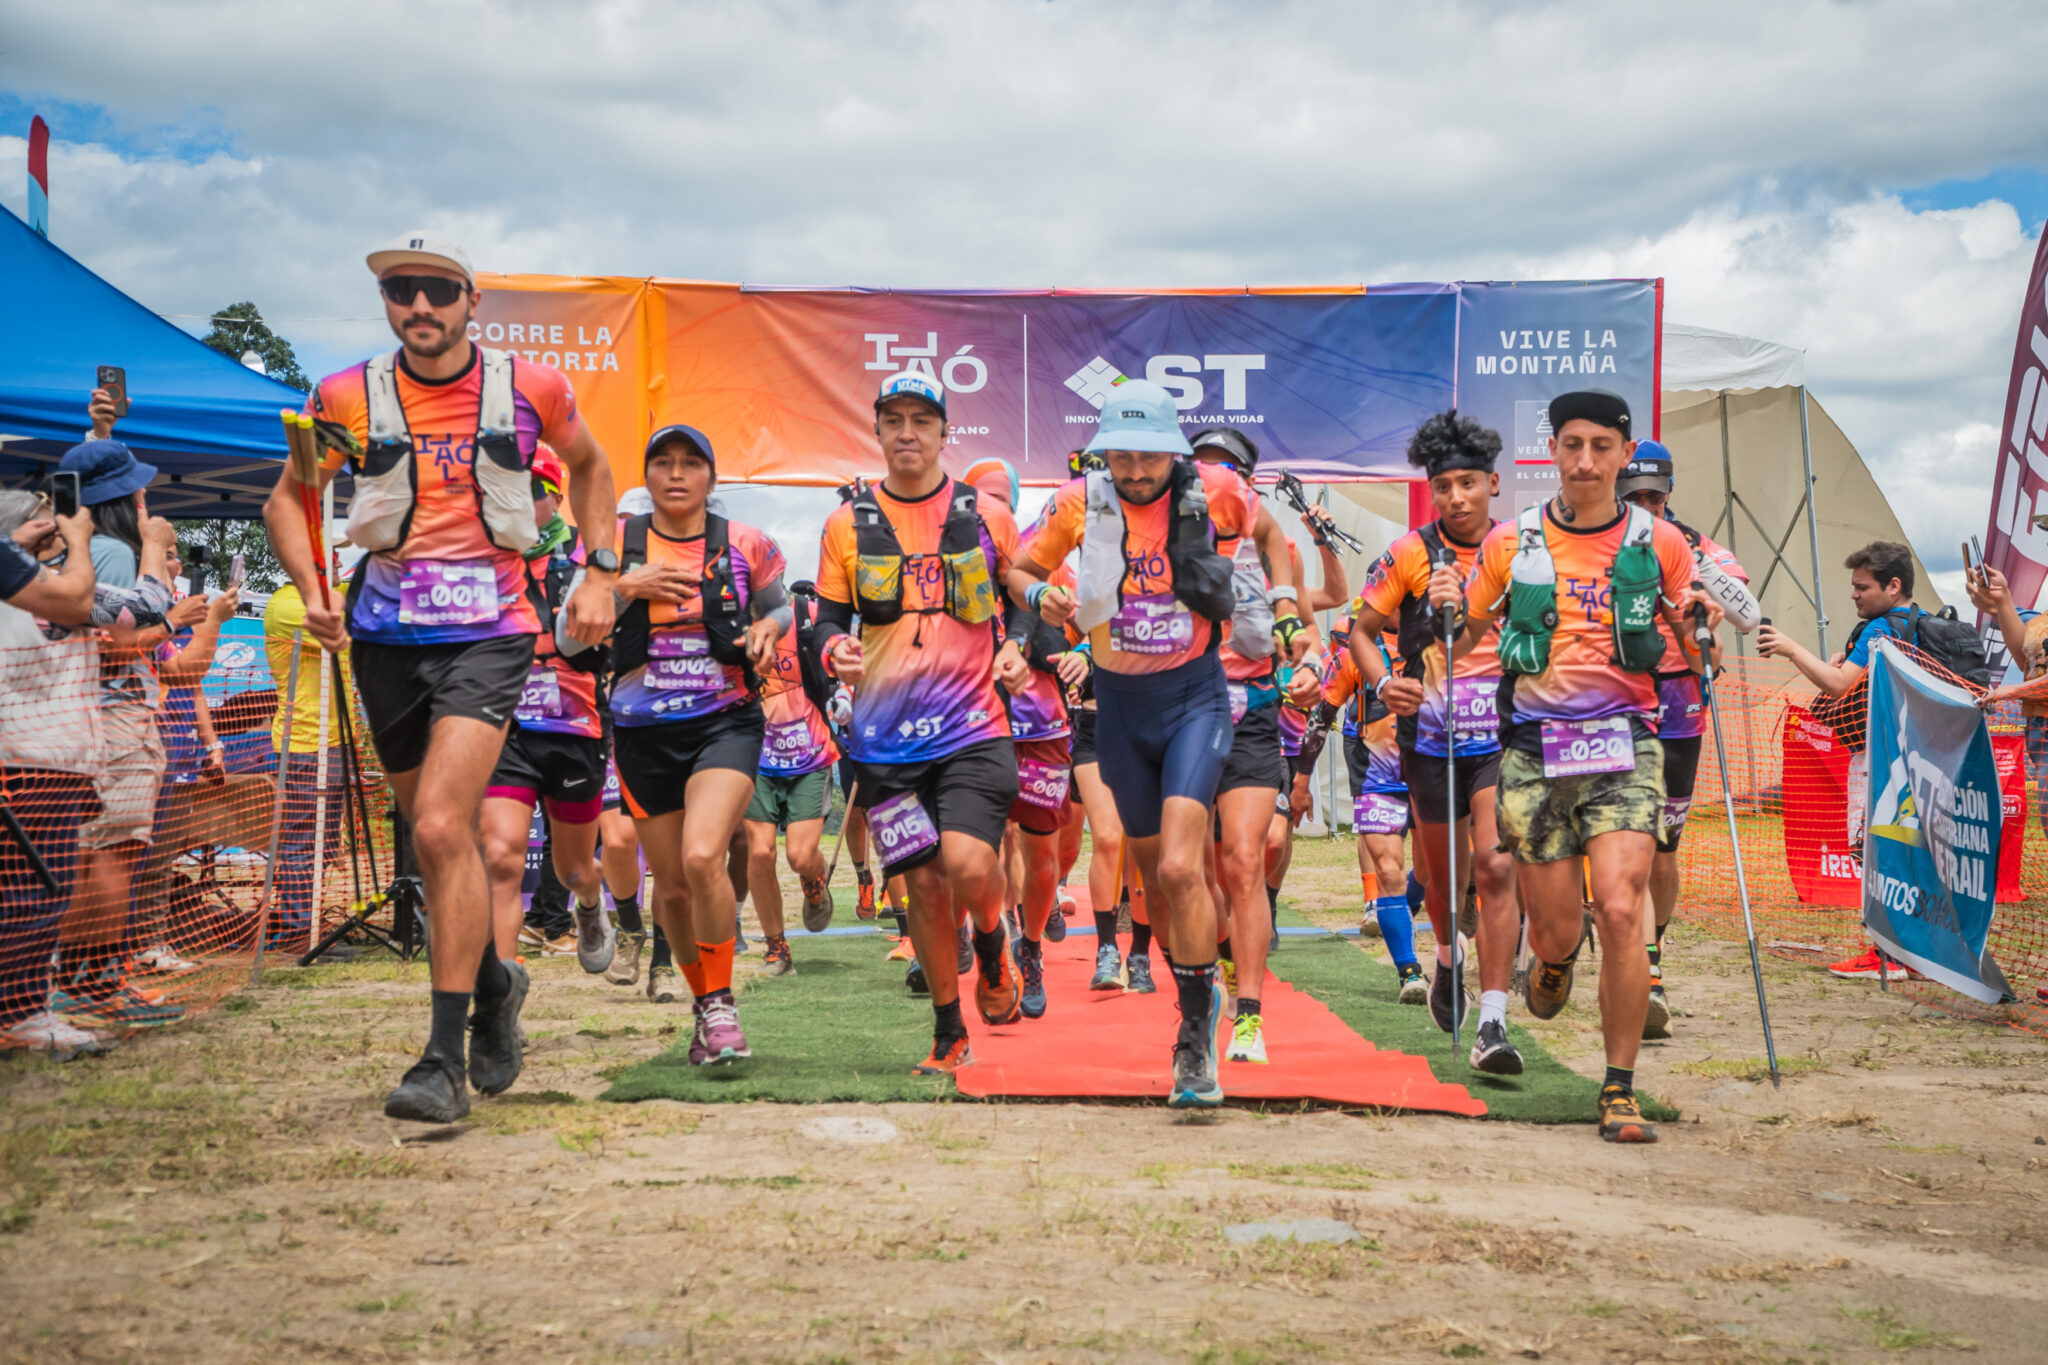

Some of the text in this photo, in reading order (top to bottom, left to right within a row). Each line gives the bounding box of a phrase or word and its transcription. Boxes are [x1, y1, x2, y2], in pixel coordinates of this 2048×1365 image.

[466, 321, 613, 346] CORRE LA
[1500, 329, 1617, 349] VIVE LA
[1476, 351, 1617, 375] MONTAÑA
[1145, 354, 1266, 411] ST
[1228, 415, 1265, 424] VIDAS
[430, 584, 488, 607] 001
[1711, 574, 1754, 620] PEPE
[1134, 617, 1185, 641] 029
[1470, 696, 1497, 717] 01
[915, 715, 945, 737] ST
[1570, 736, 1626, 761] 020
[880, 813, 923, 848] 015
